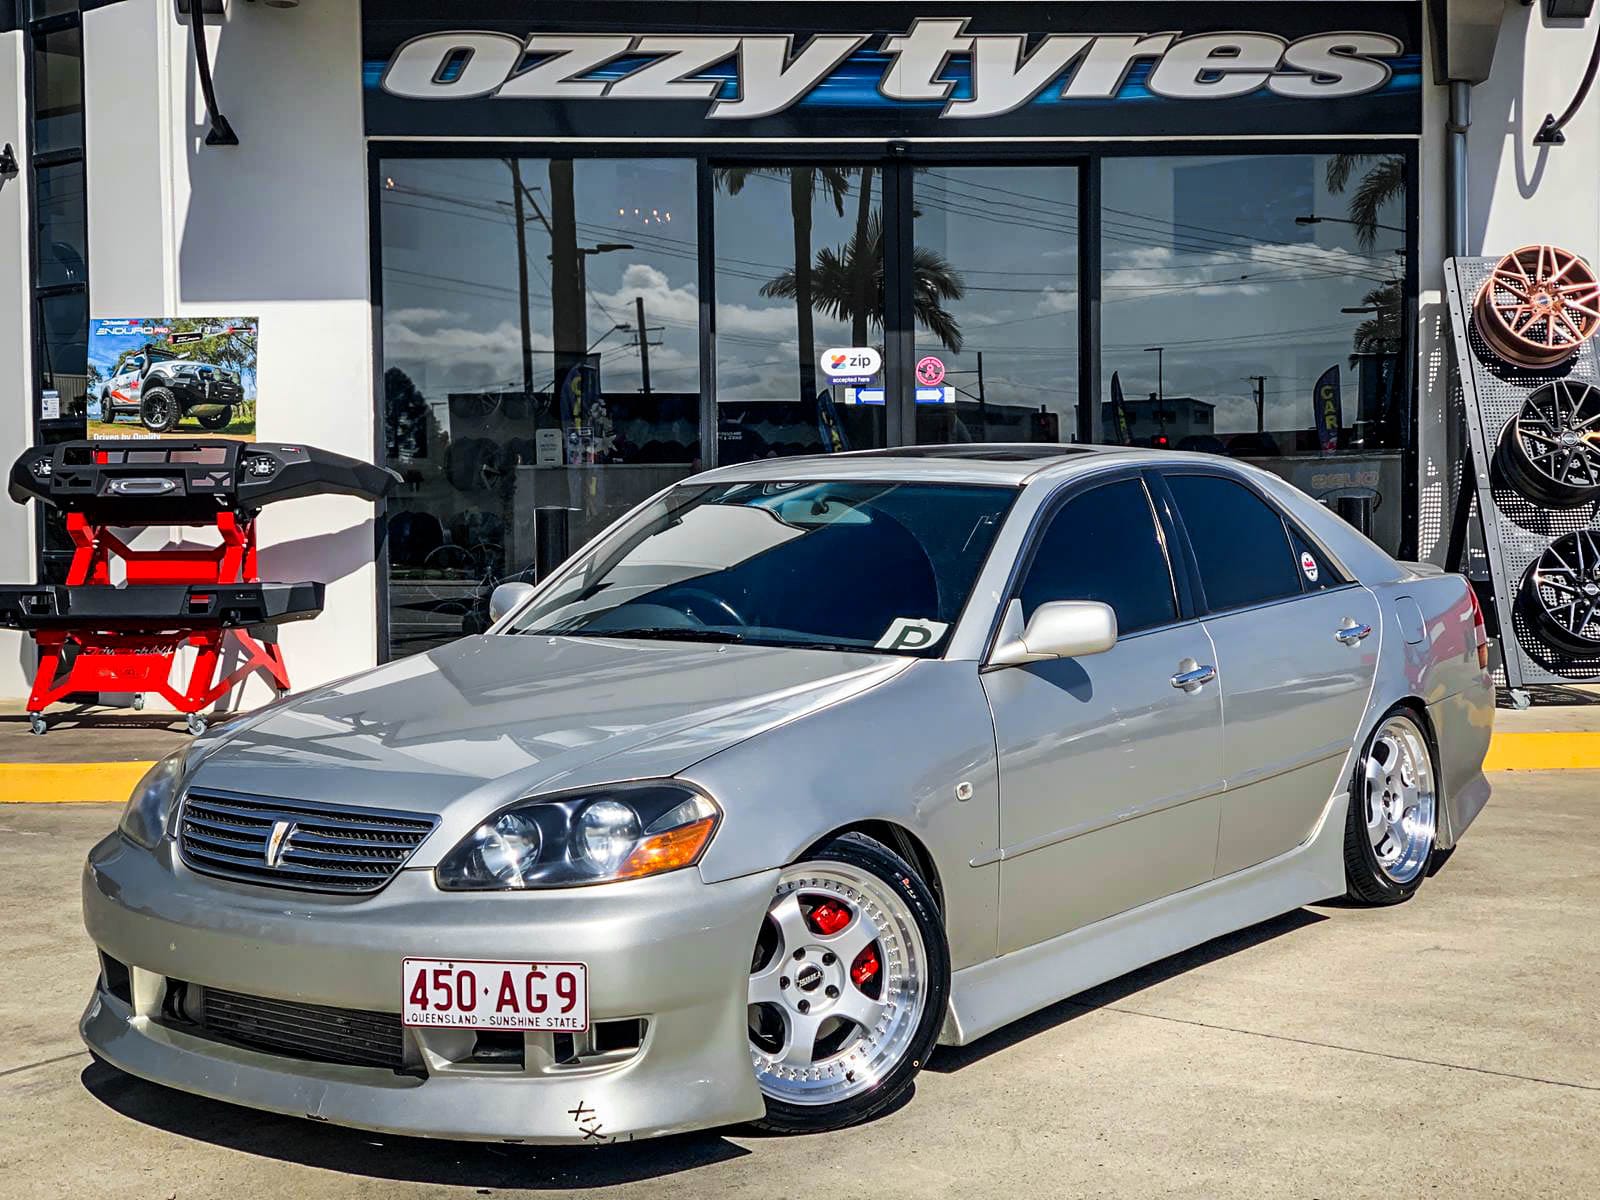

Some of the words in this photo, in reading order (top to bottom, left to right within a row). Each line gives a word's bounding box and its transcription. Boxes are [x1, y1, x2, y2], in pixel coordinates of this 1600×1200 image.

[379, 30, 874, 120] ozzy
[876, 16, 1404, 119] tyres
[850, 354, 871, 368] zip
[1320, 385, 1338, 430] CAR
[889, 625, 931, 649] P
[409, 968, 477, 1012] 450
[495, 970, 577, 1014] AG9
[411, 1013, 478, 1025] QUEENSLAND
[489, 1017, 541, 1027] SUNSHINE
[546, 1018, 578, 1028] STATE
